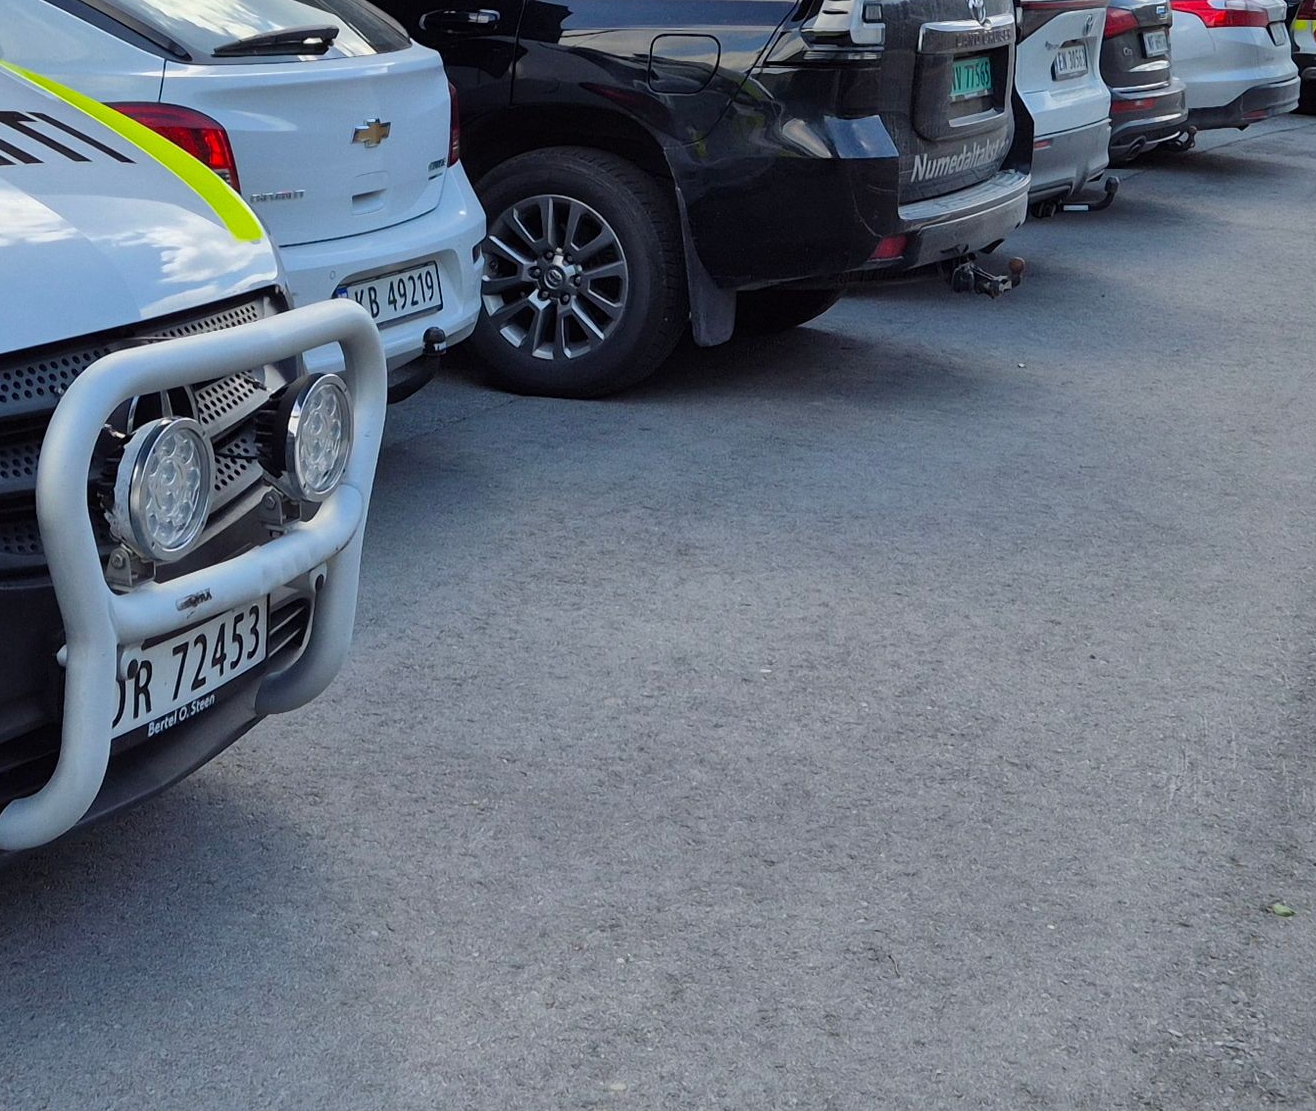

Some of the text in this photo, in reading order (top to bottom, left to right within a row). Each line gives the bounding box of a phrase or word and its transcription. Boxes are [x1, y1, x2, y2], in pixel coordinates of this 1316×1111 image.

[964, 60, 991, 89] 77565
[387, 269, 435, 312] 49219
[171, 604, 260, 702] 72453
[147, 711, 178, 738] Bertel
[190, 693, 216, 716] Steen
